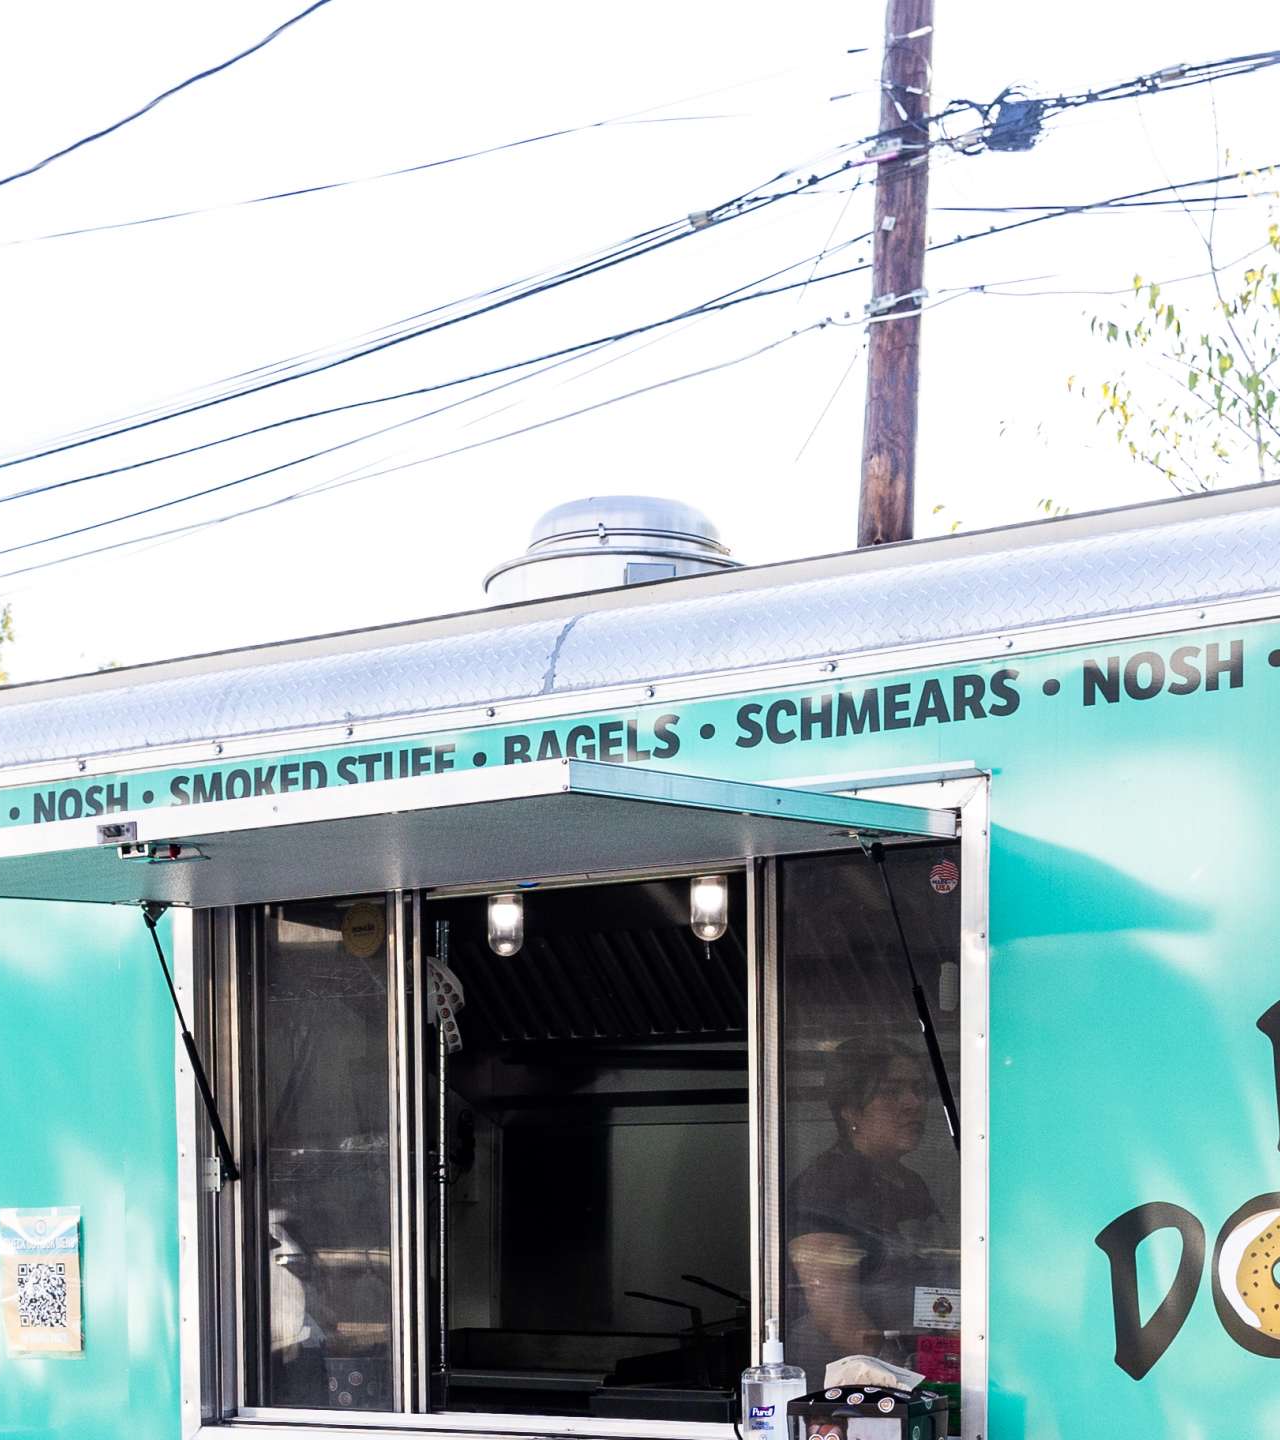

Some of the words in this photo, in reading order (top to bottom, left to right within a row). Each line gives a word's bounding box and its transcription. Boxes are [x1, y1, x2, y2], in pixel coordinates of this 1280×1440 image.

[33, 782, 129, 823] NOSH
[169, 760, 328, 807] SMOKED
[336, 743, 456, 787] STUFF
[504, 713, 681, 765] BAGELS
[735, 668, 1021, 748] SCHMEARS
[1082, 639, 1245, 707] NOSH
